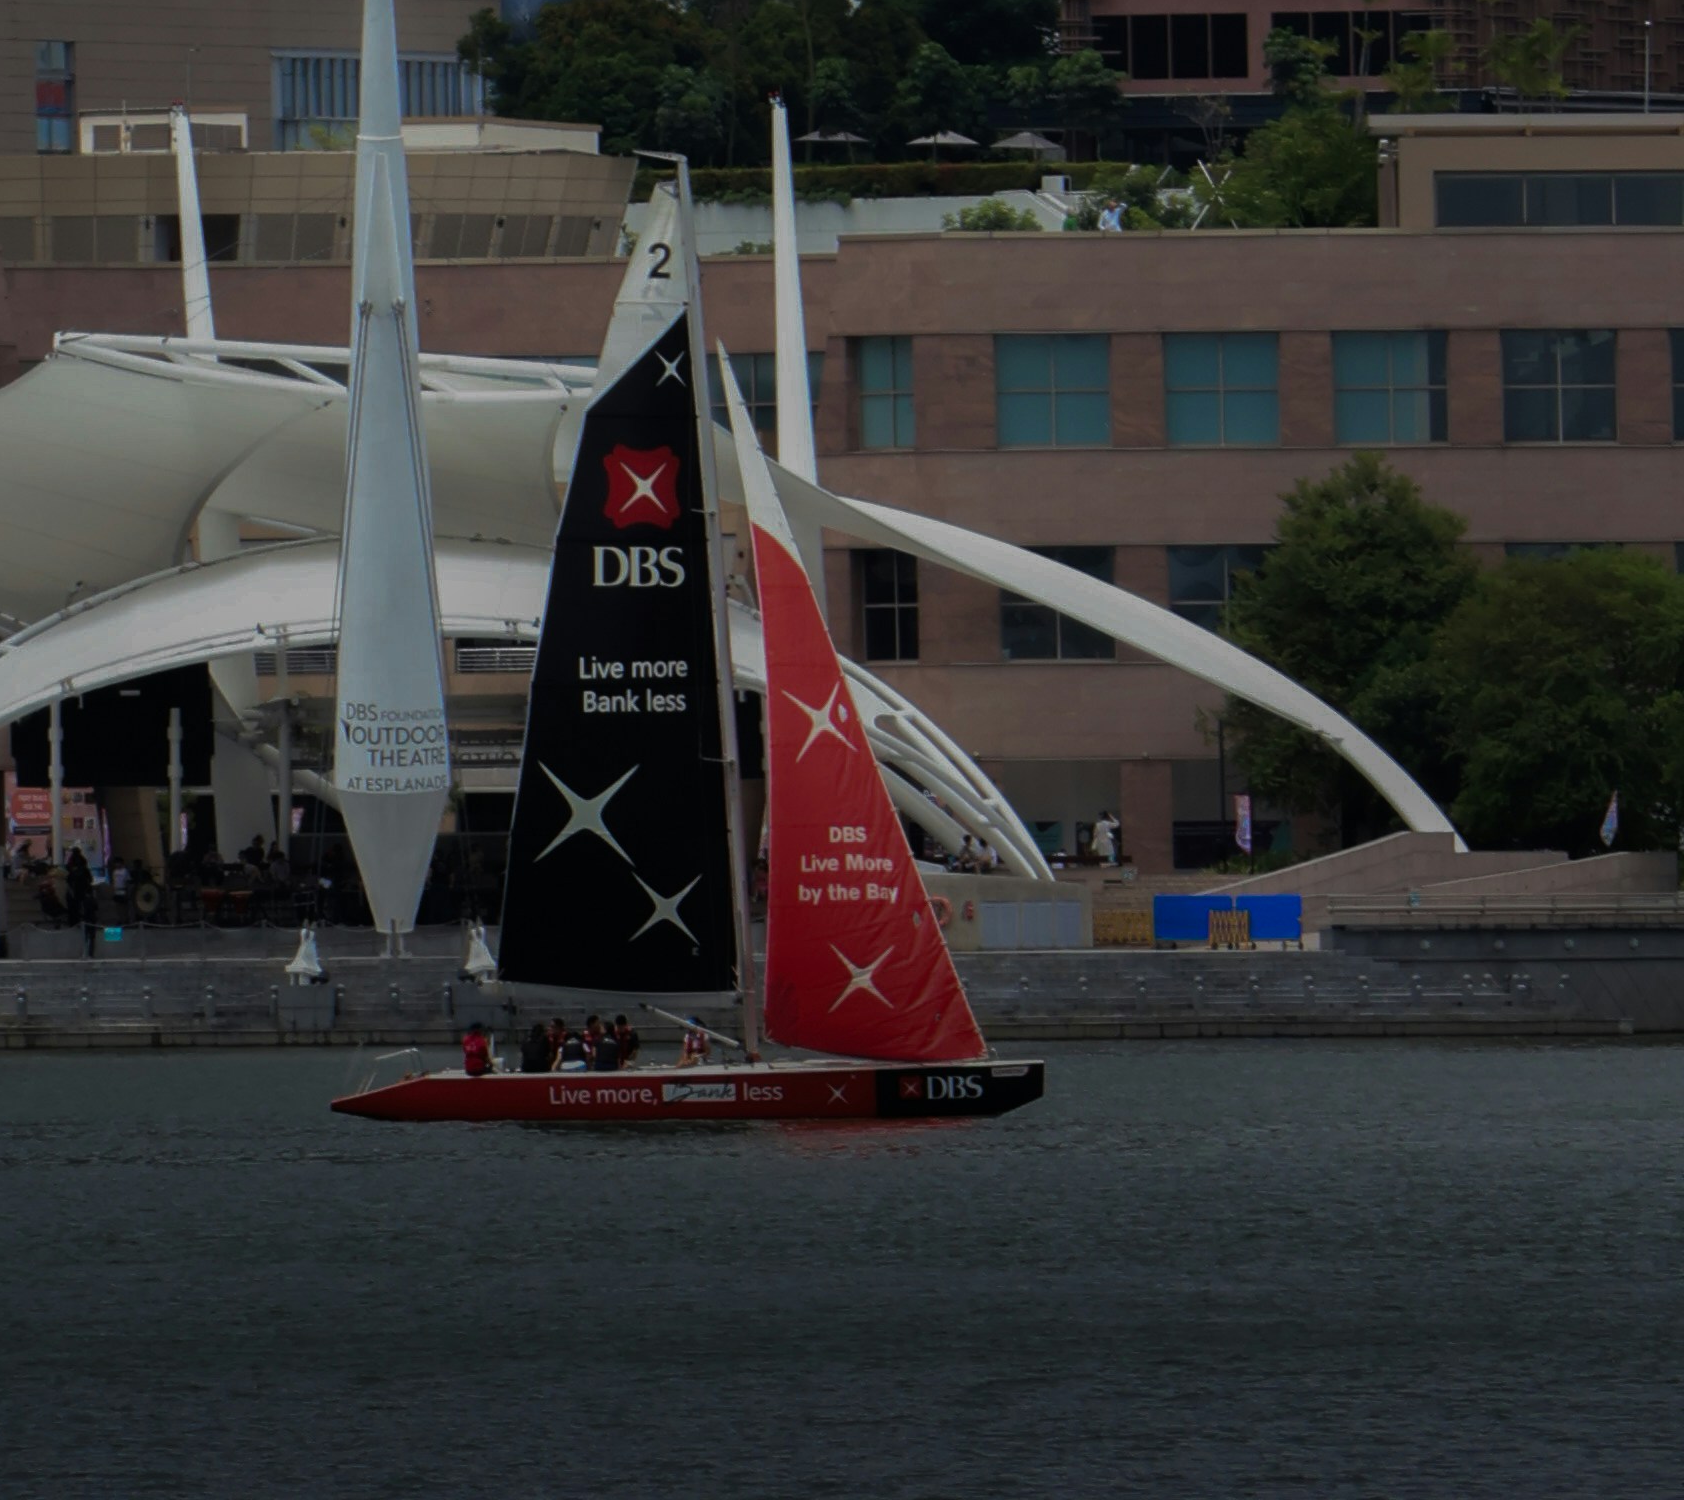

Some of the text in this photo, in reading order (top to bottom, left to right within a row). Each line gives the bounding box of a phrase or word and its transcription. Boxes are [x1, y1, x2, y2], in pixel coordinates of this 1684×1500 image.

[649, 242, 671, 279] 2
[592, 545, 686, 588] DBS
[578, 656, 689, 680] Live more
[346, 702, 378, 722] DBS
[582, 688, 687, 713] Bank less
[351, 724, 445, 745] OUTDOOR
[367, 747, 446, 767] THEATRE
[347, 775, 447, 792] AT ESPLANADE
[828, 826, 868, 843] DBS
[800, 853, 894, 873] Live More
[797, 883, 899, 906] by the Bay
[548, 1078, 784, 1106] Live more, Bank less
[926, 1074, 985, 1100] DBS
